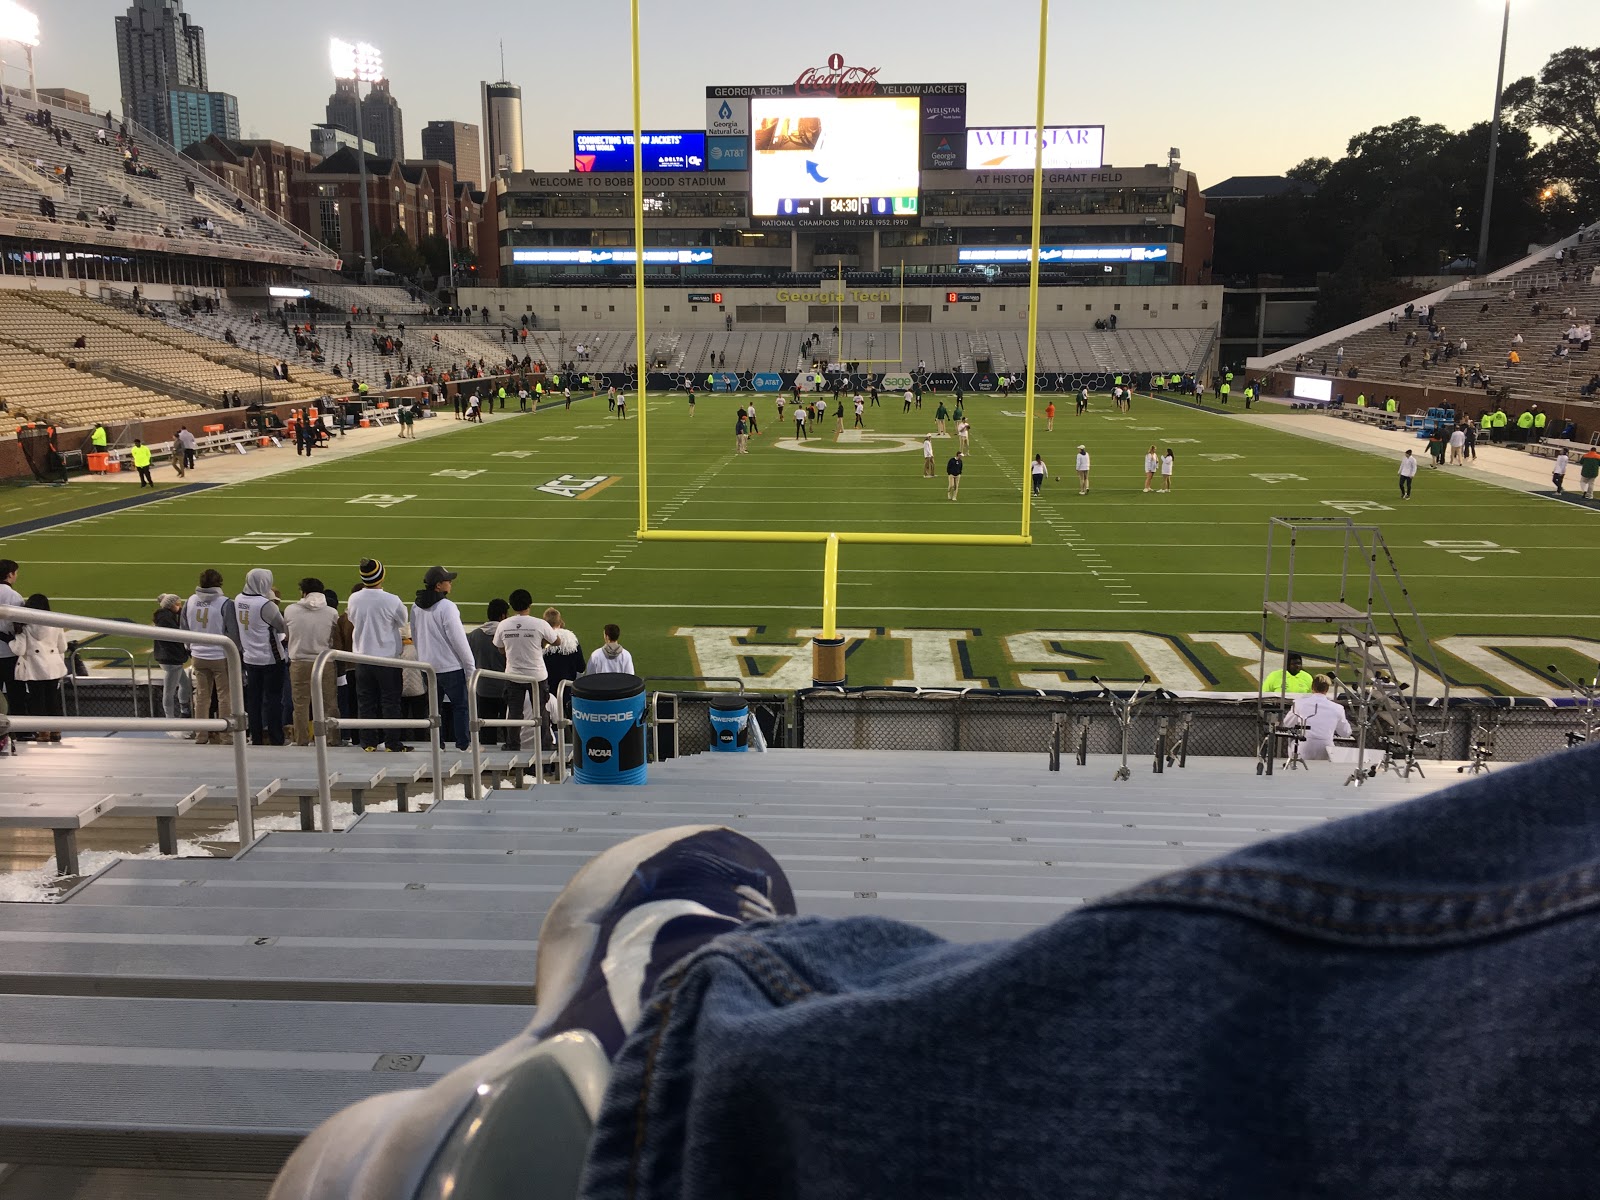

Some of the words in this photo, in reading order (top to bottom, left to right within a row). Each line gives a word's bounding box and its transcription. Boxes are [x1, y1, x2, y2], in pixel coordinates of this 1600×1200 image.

[714, 87, 757, 97] GEORGIA
[759, 87, 784, 96] TECH
[882, 85, 920, 95] YELLOW
[922, 84, 966, 94] JACKETS
[713, 121, 738, 129] Georgia
[723, 149, 745, 158] AT&T
[931, 152, 956, 161] Georgia
[530, 177, 583, 187] WELCOME
[587, 177, 602, 186] TO
[605, 177, 635, 186] BOBB
[645, 177, 675, 186] DODD
[678, 177, 726, 186] STADIUM
[976, 175, 990, 184] AT
[993, 174, 1045, 183] HISTORC
[1049, 173, 1087, 183] GRANT
[1091, 173, 1122, 182] FIELD
[830, 199, 858, 212] 84:30
[776, 289, 845, 304] Georgia
[851, 290, 890, 302] Tech
[884, 377, 911, 388] sage
[195, 607, 209, 629] 4
[239, 610, 250, 631] 4
[588, 748, 612, 757] NCAA
